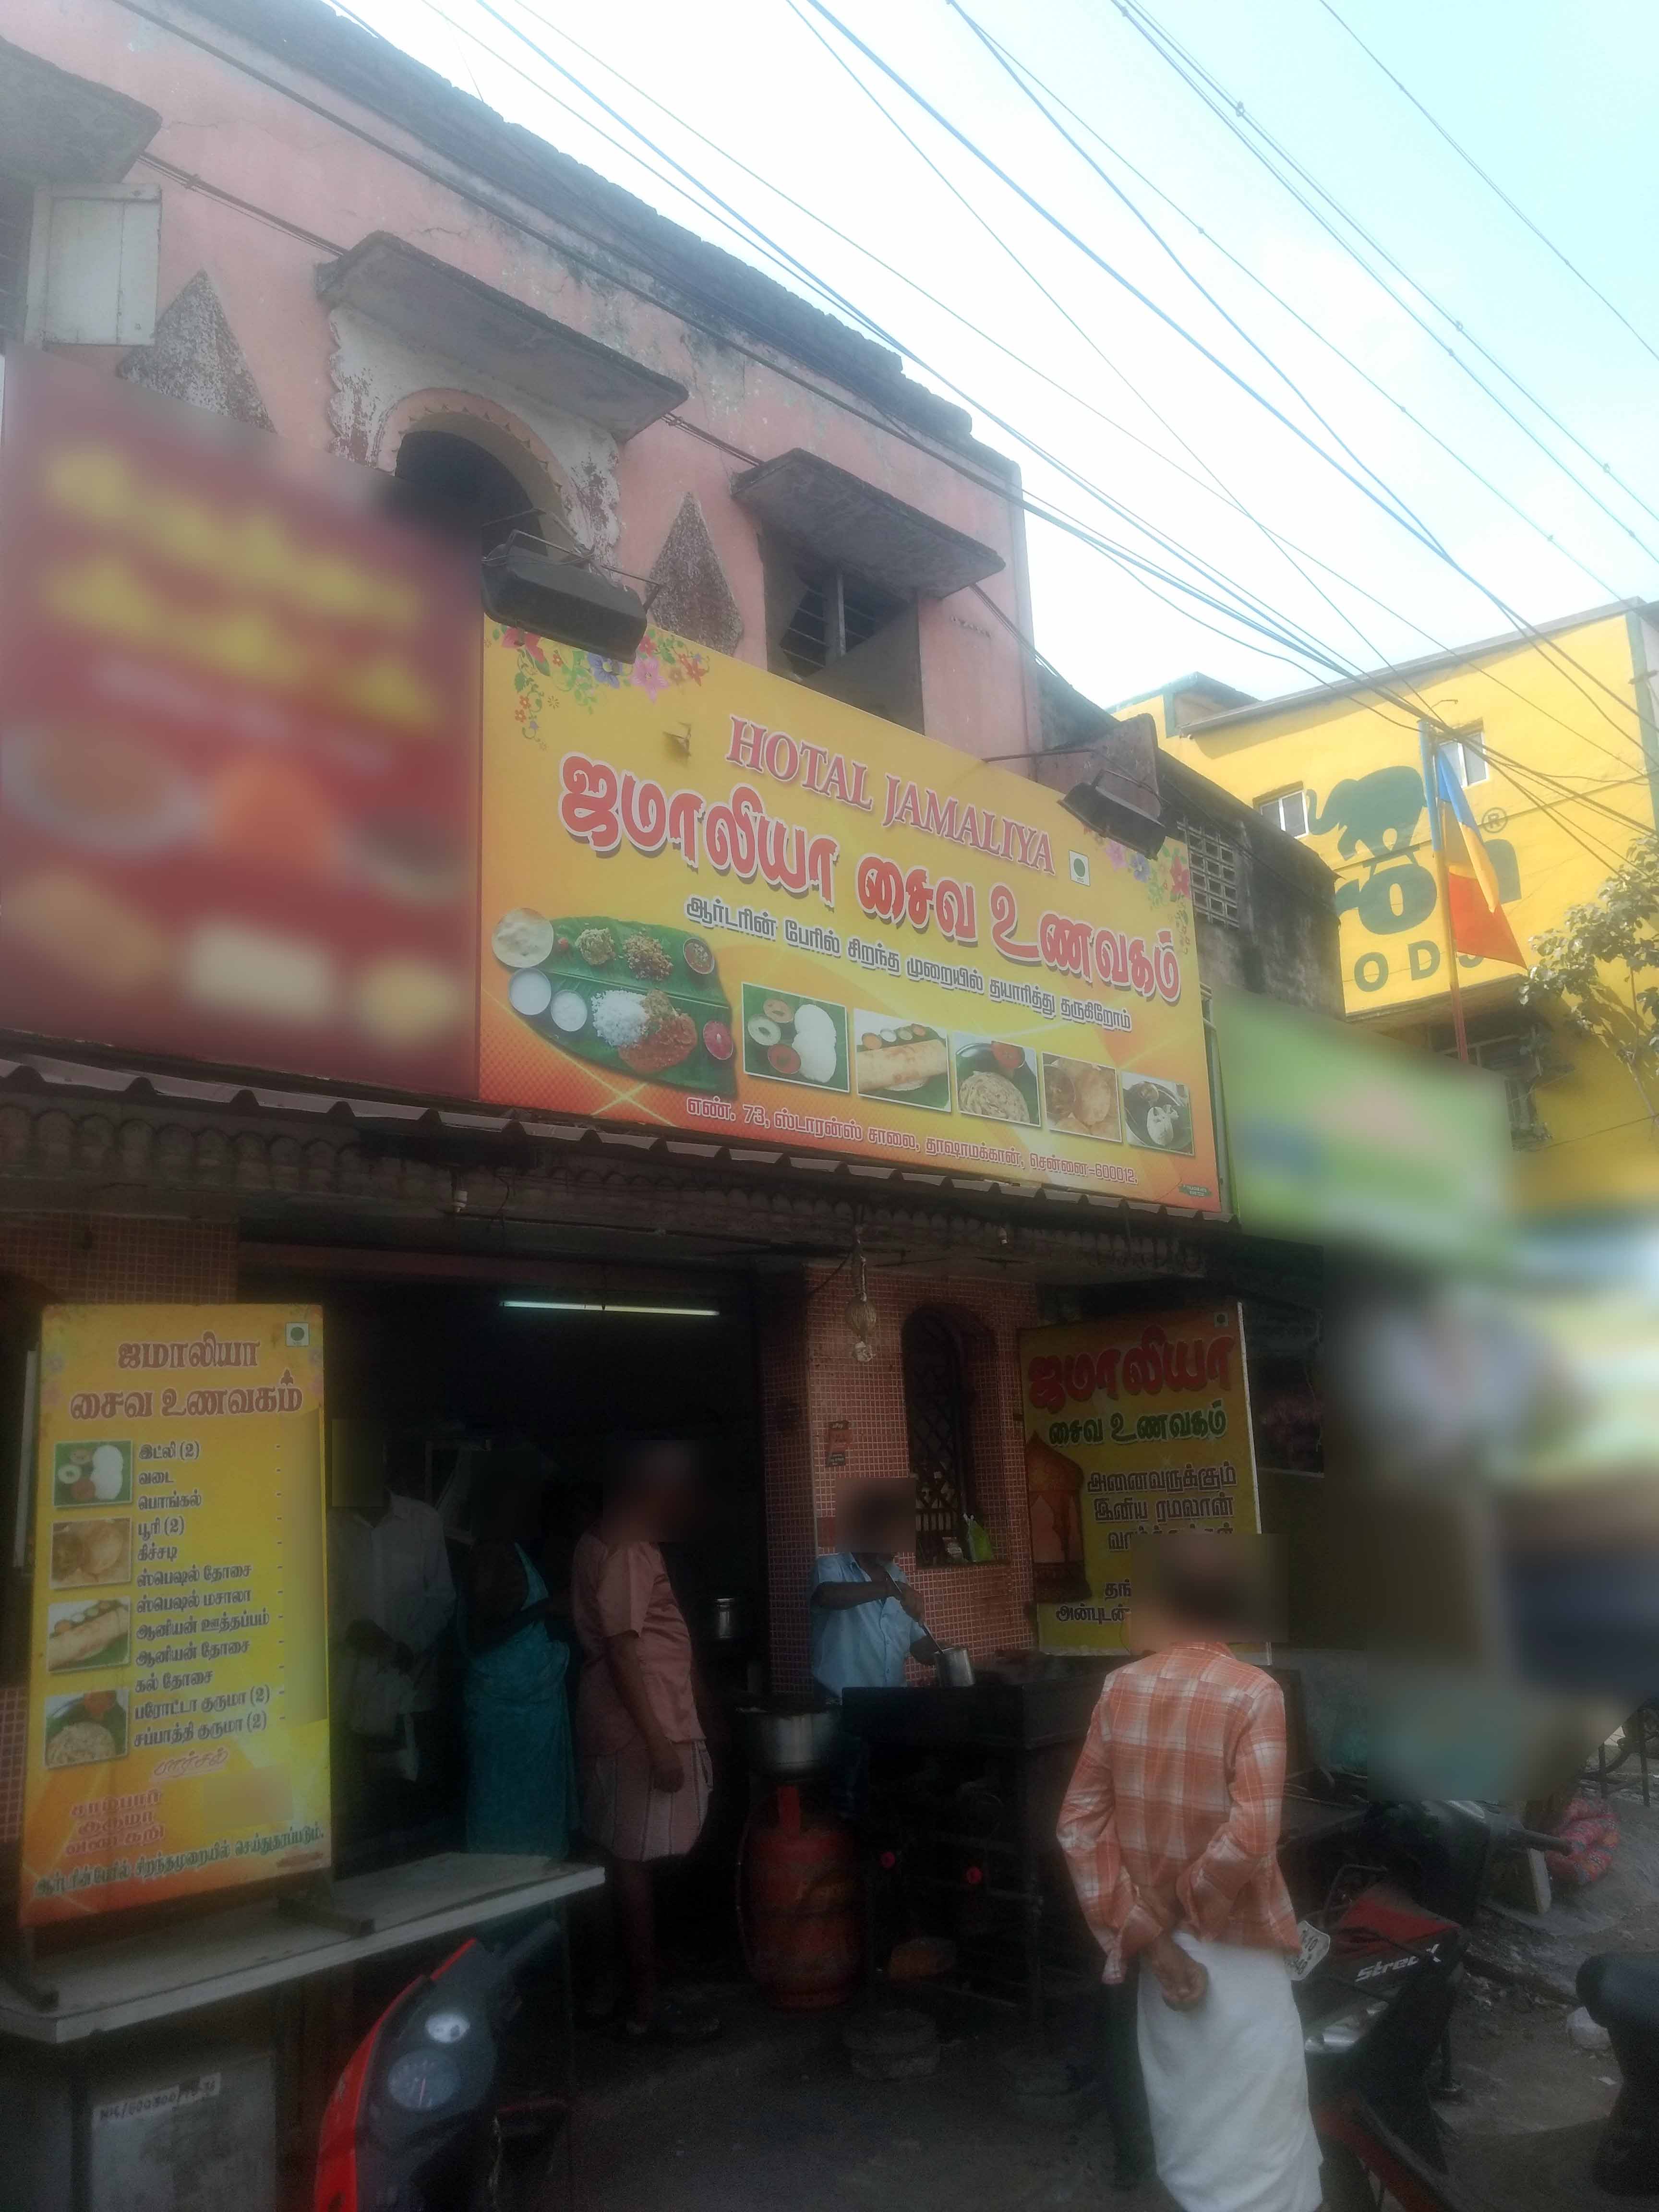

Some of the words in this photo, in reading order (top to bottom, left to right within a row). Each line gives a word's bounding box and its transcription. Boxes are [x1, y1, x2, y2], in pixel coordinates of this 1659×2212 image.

[726, 715, 873, 811] HOTAL
[882, 773, 1055, 875] JAMALIYA
[558, 752, 839, 908] ஜமாலியா
[855, 854, 978, 942] சைவ
[989, 882, 1181, 1002] உணவகம்
[685, 895, 777, 939] ஆர்டரின்
[784, 917, 841, 956] பேரில்
[846, 937, 901, 975] சிறந்த
[906, 956, 984, 993] முறையில்
[989, 977, 1056, 1018] தயாரித்து
[1060, 997, 1132, 1031] தருகிறோம்
[743, 1105, 770, 1128] 73,
[118, 1330, 260, 1369] ஜமாலியா
[1028, 1324, 1236, 1411] ஜமாலியா
[70, 1389, 153, 1419] சைவ
[161, 1369, 303, 1417] உணவகம்
[1049, 1419, 1103, 1447] சைவ
[1110, 1400, 1227, 1443] உணவகம்
[138, 1472, 174, 1484] வடை
[1088, 1460, 1237, 1493] அனைவருக்கும்
[138, 1489, 202, 1509] பொங்கல்
[1094, 1497, 1148, 1524] இனிய
[1156, 1492, 1235, 1525] ரமலான்
[204, 1564, 252, 1582] தோசை
[204, 1590, 251, 1606] மசாலா
